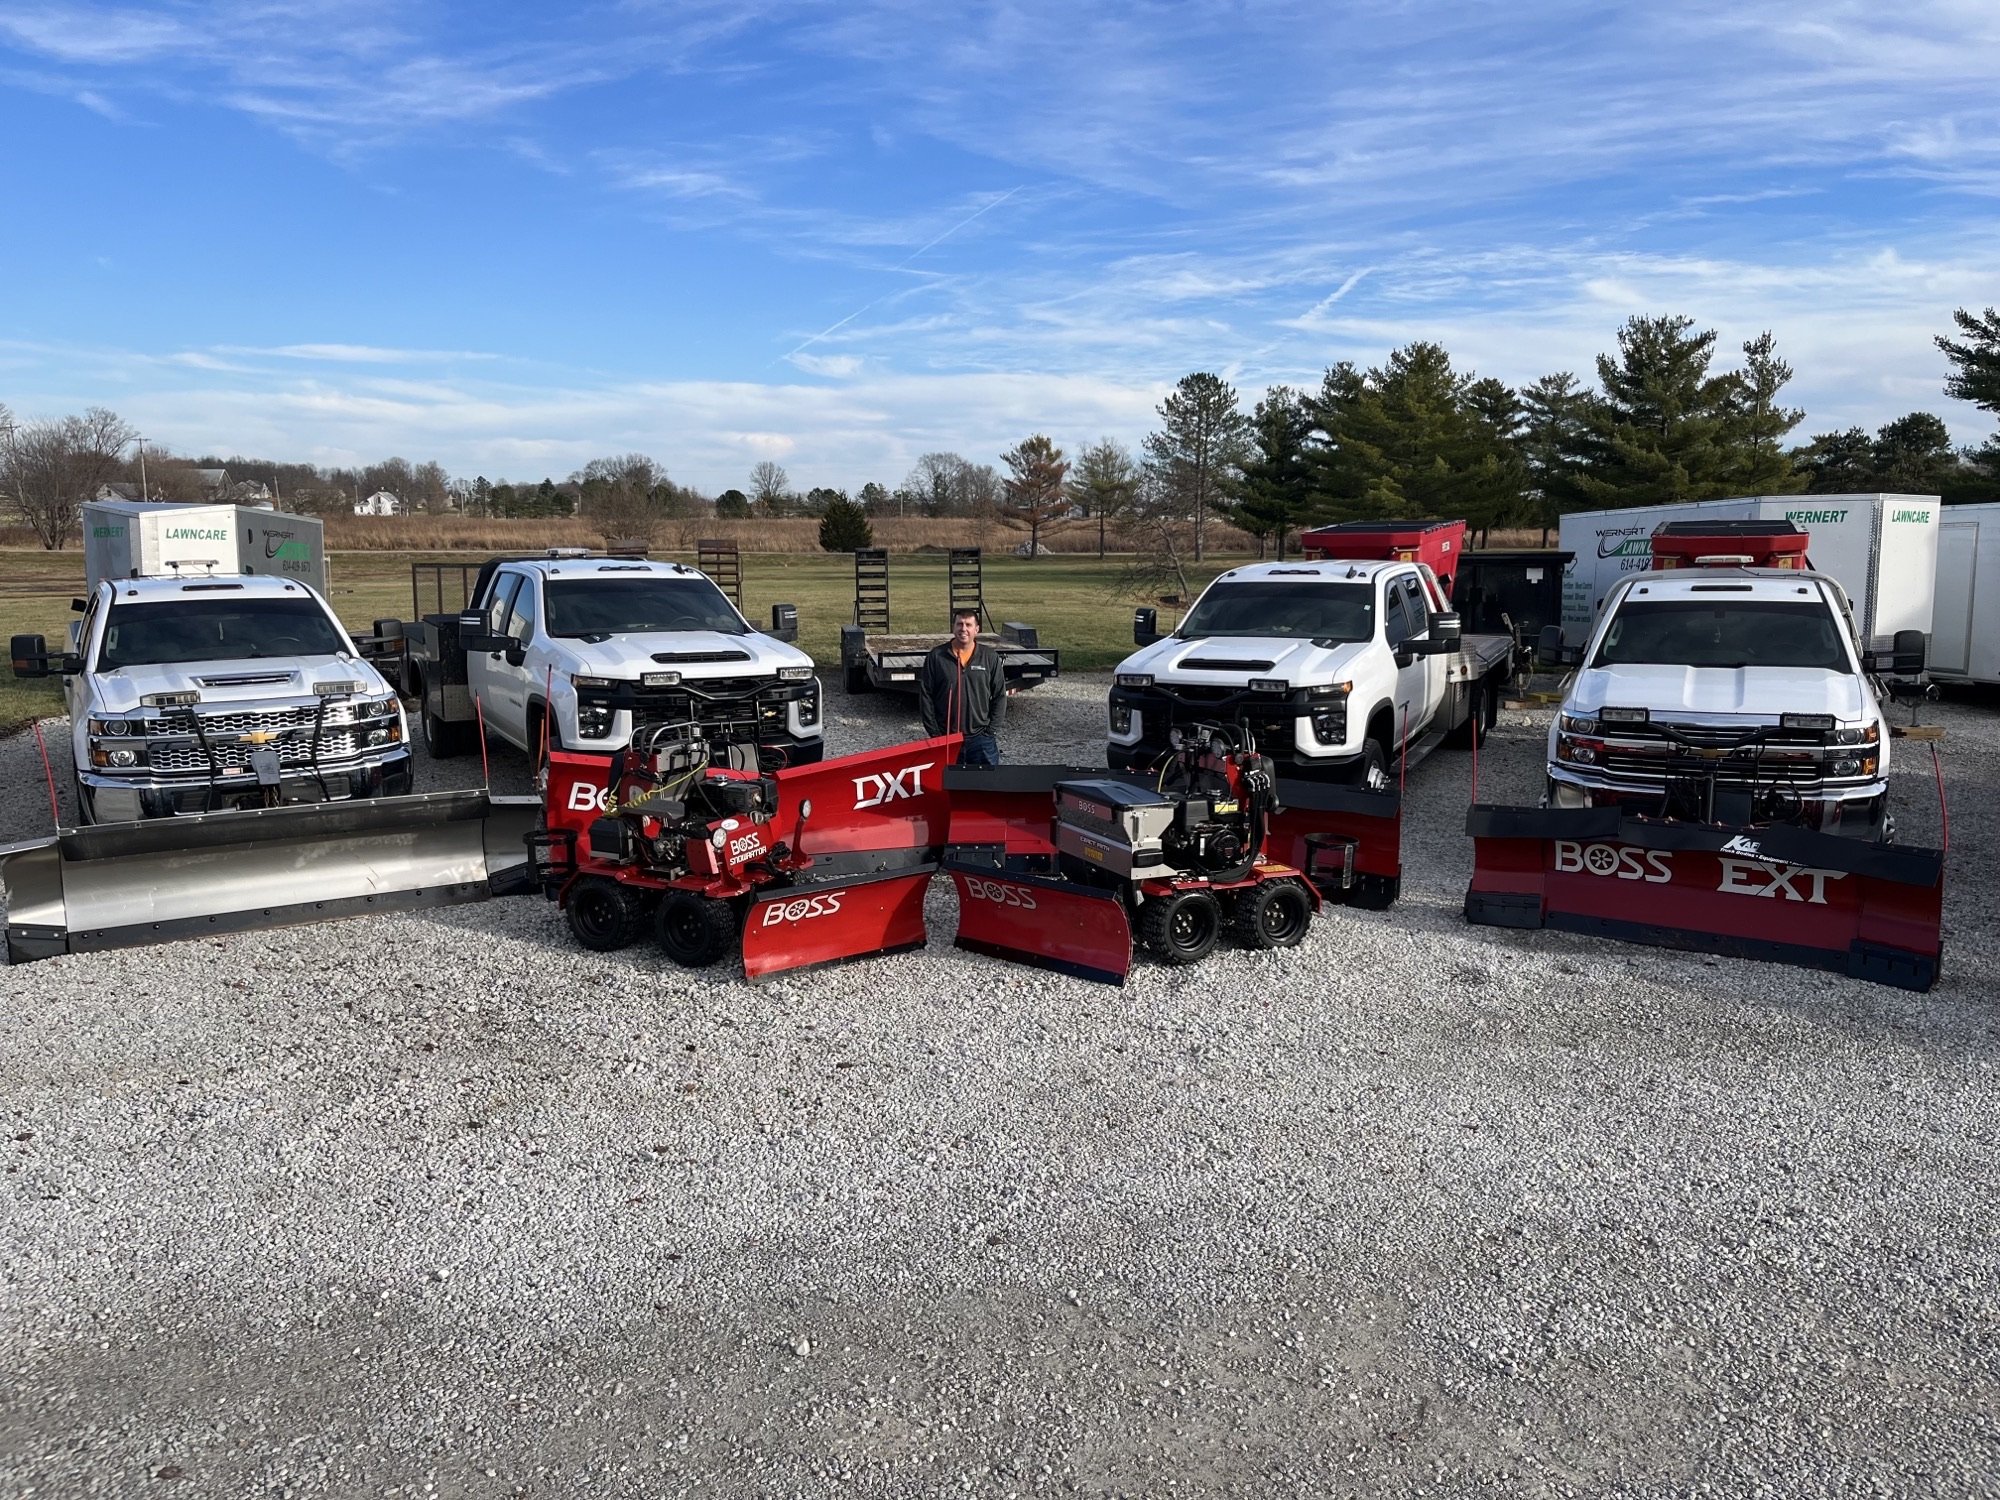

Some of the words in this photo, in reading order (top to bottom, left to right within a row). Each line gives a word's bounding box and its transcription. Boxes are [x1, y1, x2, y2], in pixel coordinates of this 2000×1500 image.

[1786, 510, 1848, 523] WERNERT
[1892, 510, 1930, 523] LAWNCARE
[166, 528, 227, 541] LAWNCARE
[1596, 528, 1646, 537] WERNERT
[1622, 541, 1647, 554] LAWN
[852, 762, 935, 810] DXT
[1079, 801, 1095, 814] BOSS
[730, 832, 760, 855] BOSS
[1555, 840, 1673, 883] BOSS
[1716, 857, 1849, 904] EXT
[964, 876, 1037, 910] BOSS
[763, 892, 846, 927] BOSS
